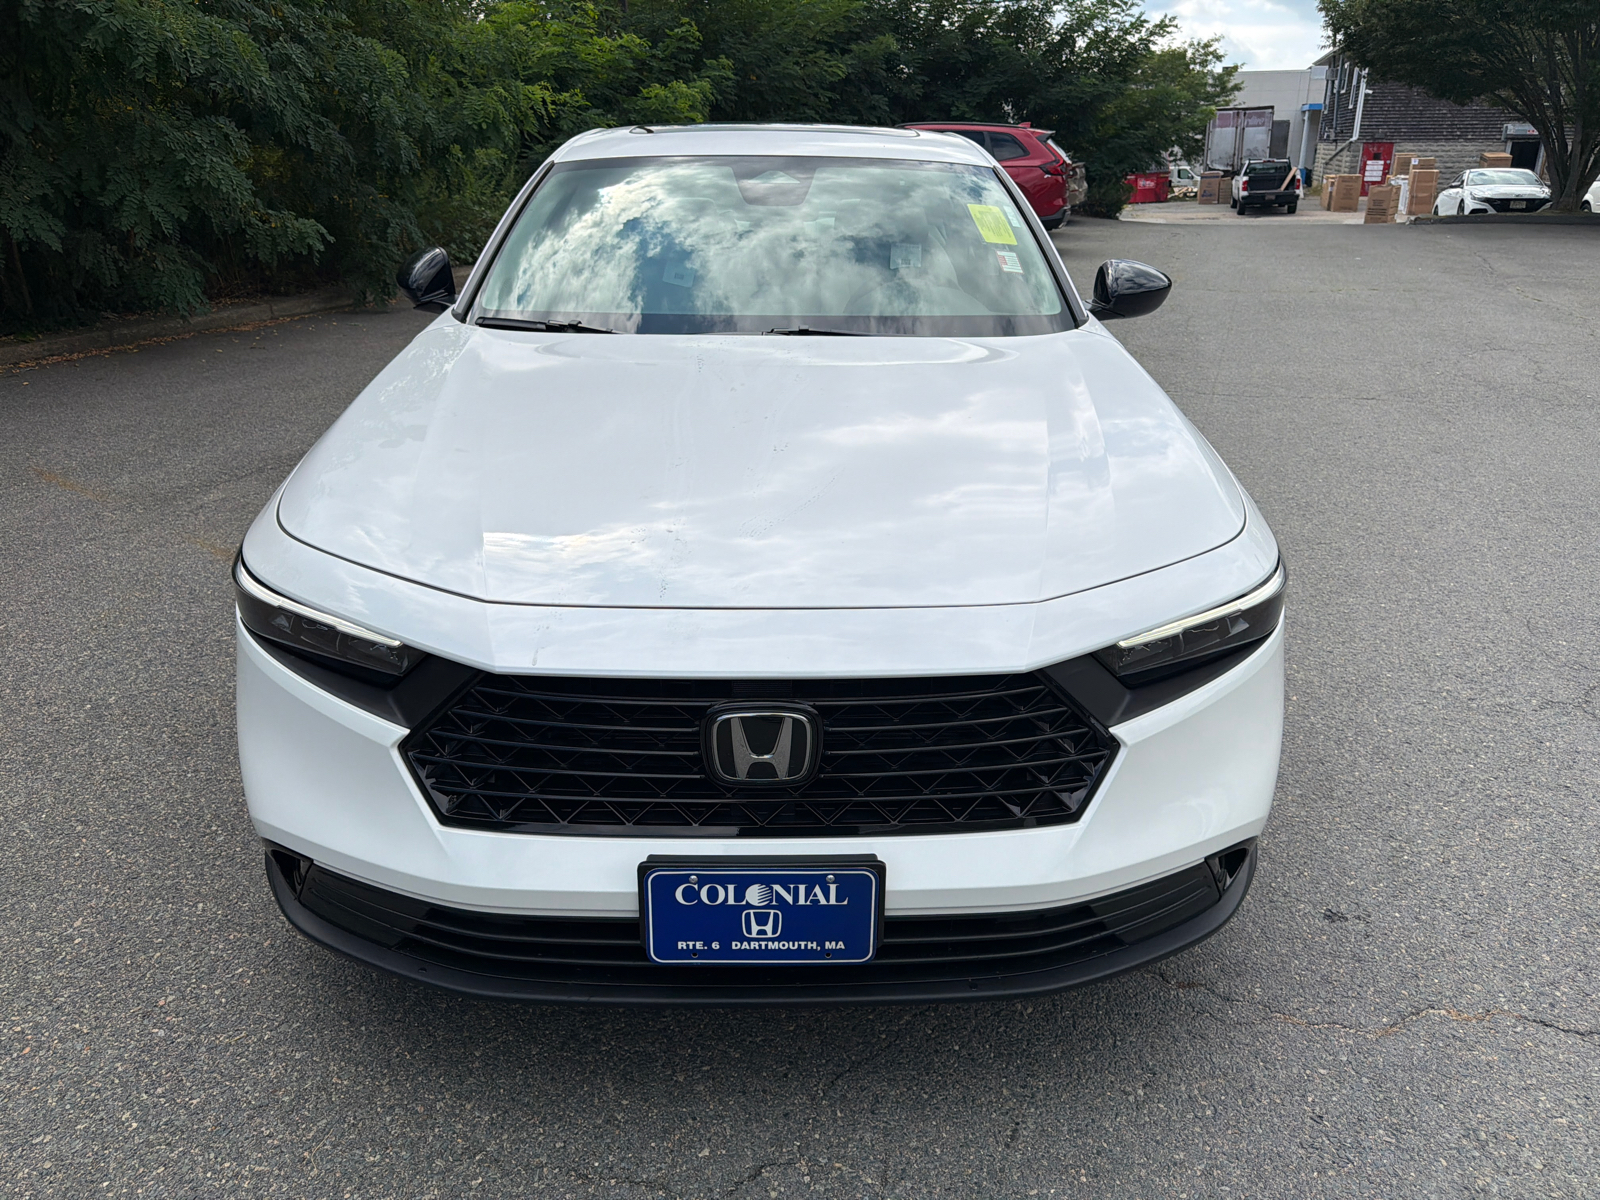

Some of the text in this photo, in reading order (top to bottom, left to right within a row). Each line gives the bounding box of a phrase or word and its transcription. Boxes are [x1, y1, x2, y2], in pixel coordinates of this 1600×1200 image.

[675, 883, 848, 906] COLONIAL
[677, 941, 720, 950] RTE. 6
[732, 941, 845, 951] DARTMOUTH, MA
